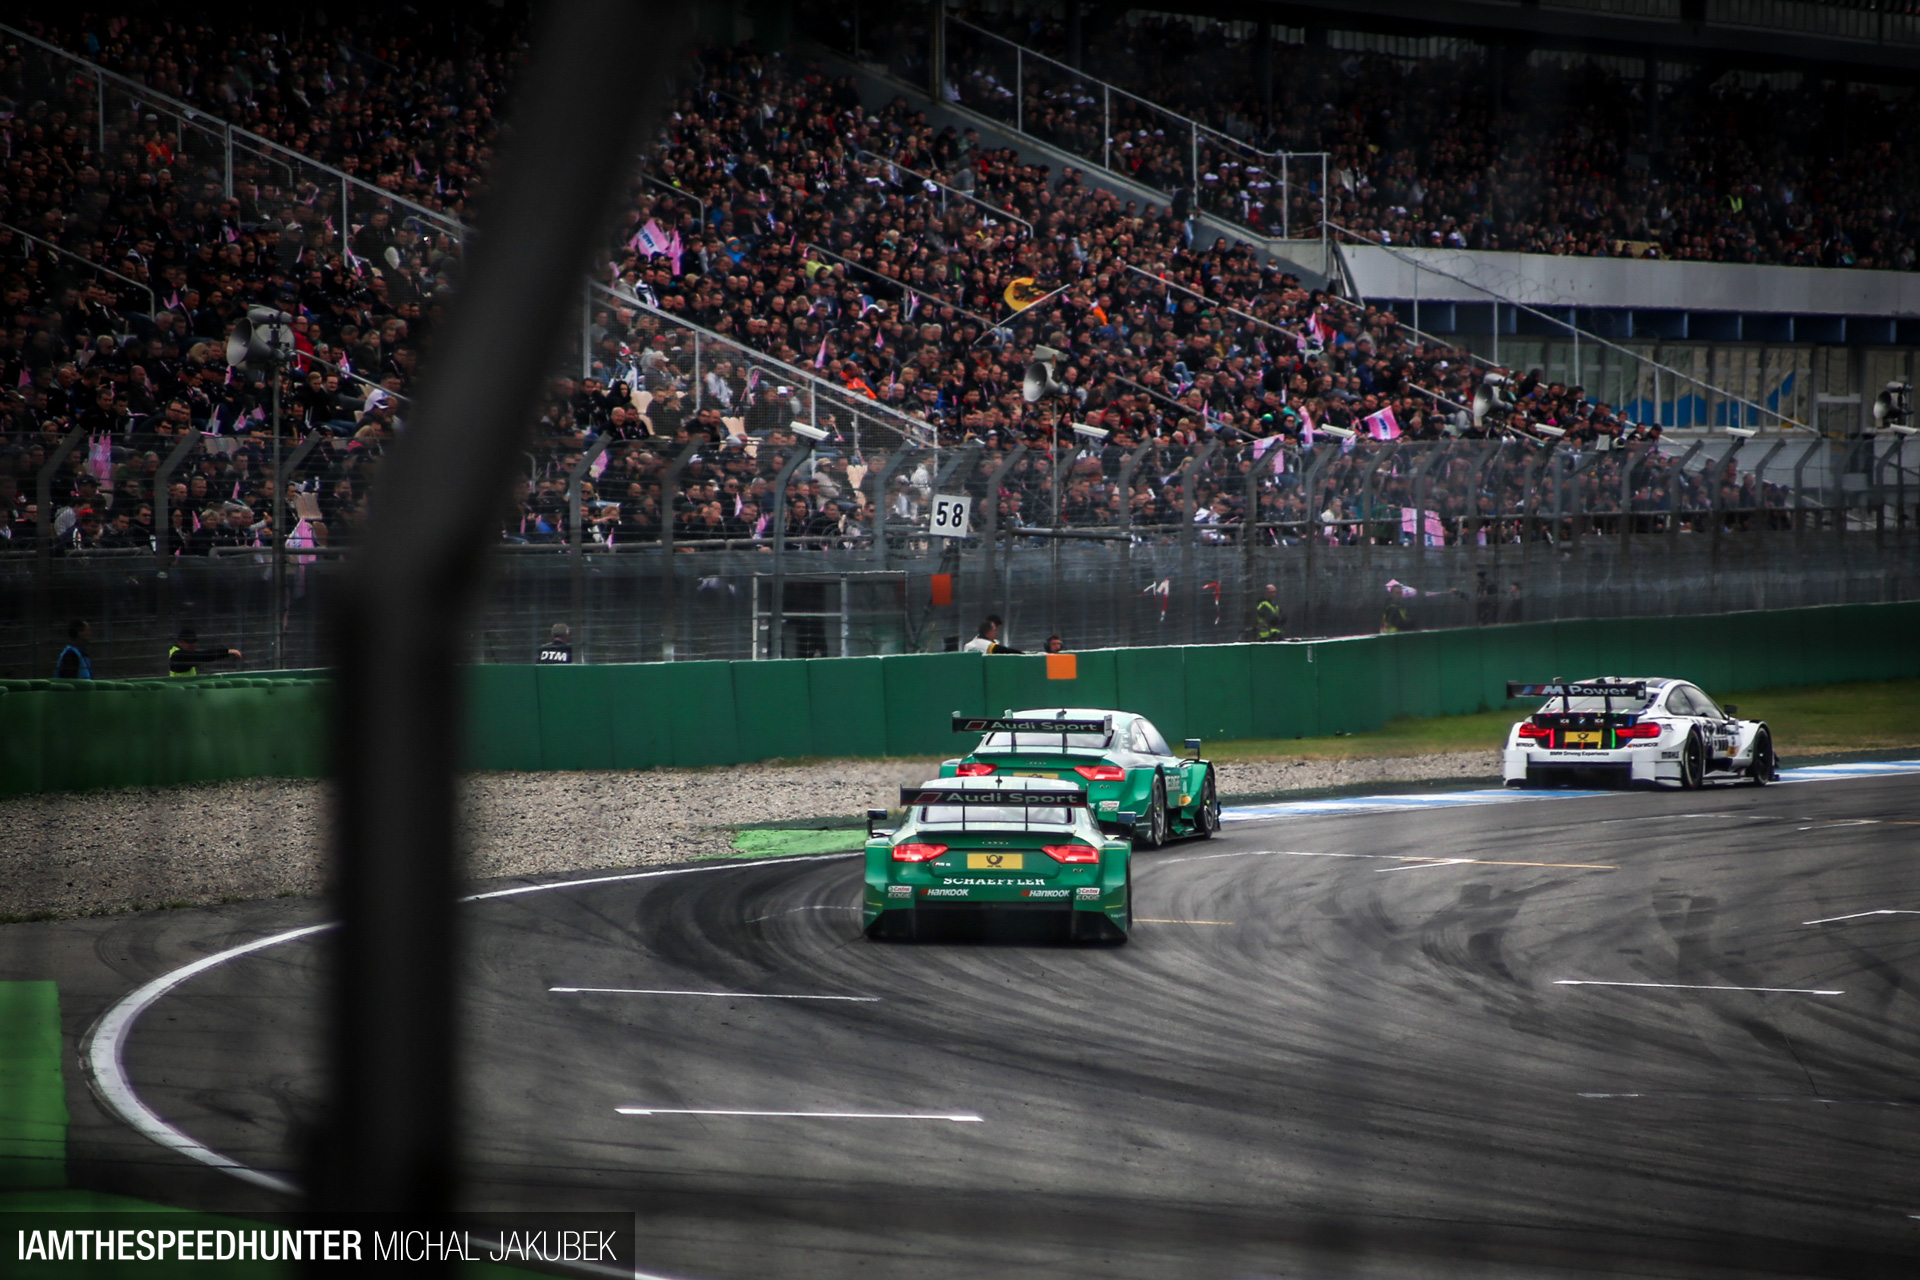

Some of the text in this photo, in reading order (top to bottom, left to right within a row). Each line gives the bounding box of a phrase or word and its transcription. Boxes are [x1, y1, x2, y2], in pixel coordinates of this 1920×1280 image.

[936, 501, 964, 528] 58
[540, 650, 568, 662] DTM
[1568, 685, 1629, 695] Power
[990, 721, 1098, 732] Audi Sport
[946, 792, 1078, 804] Audi Sport
